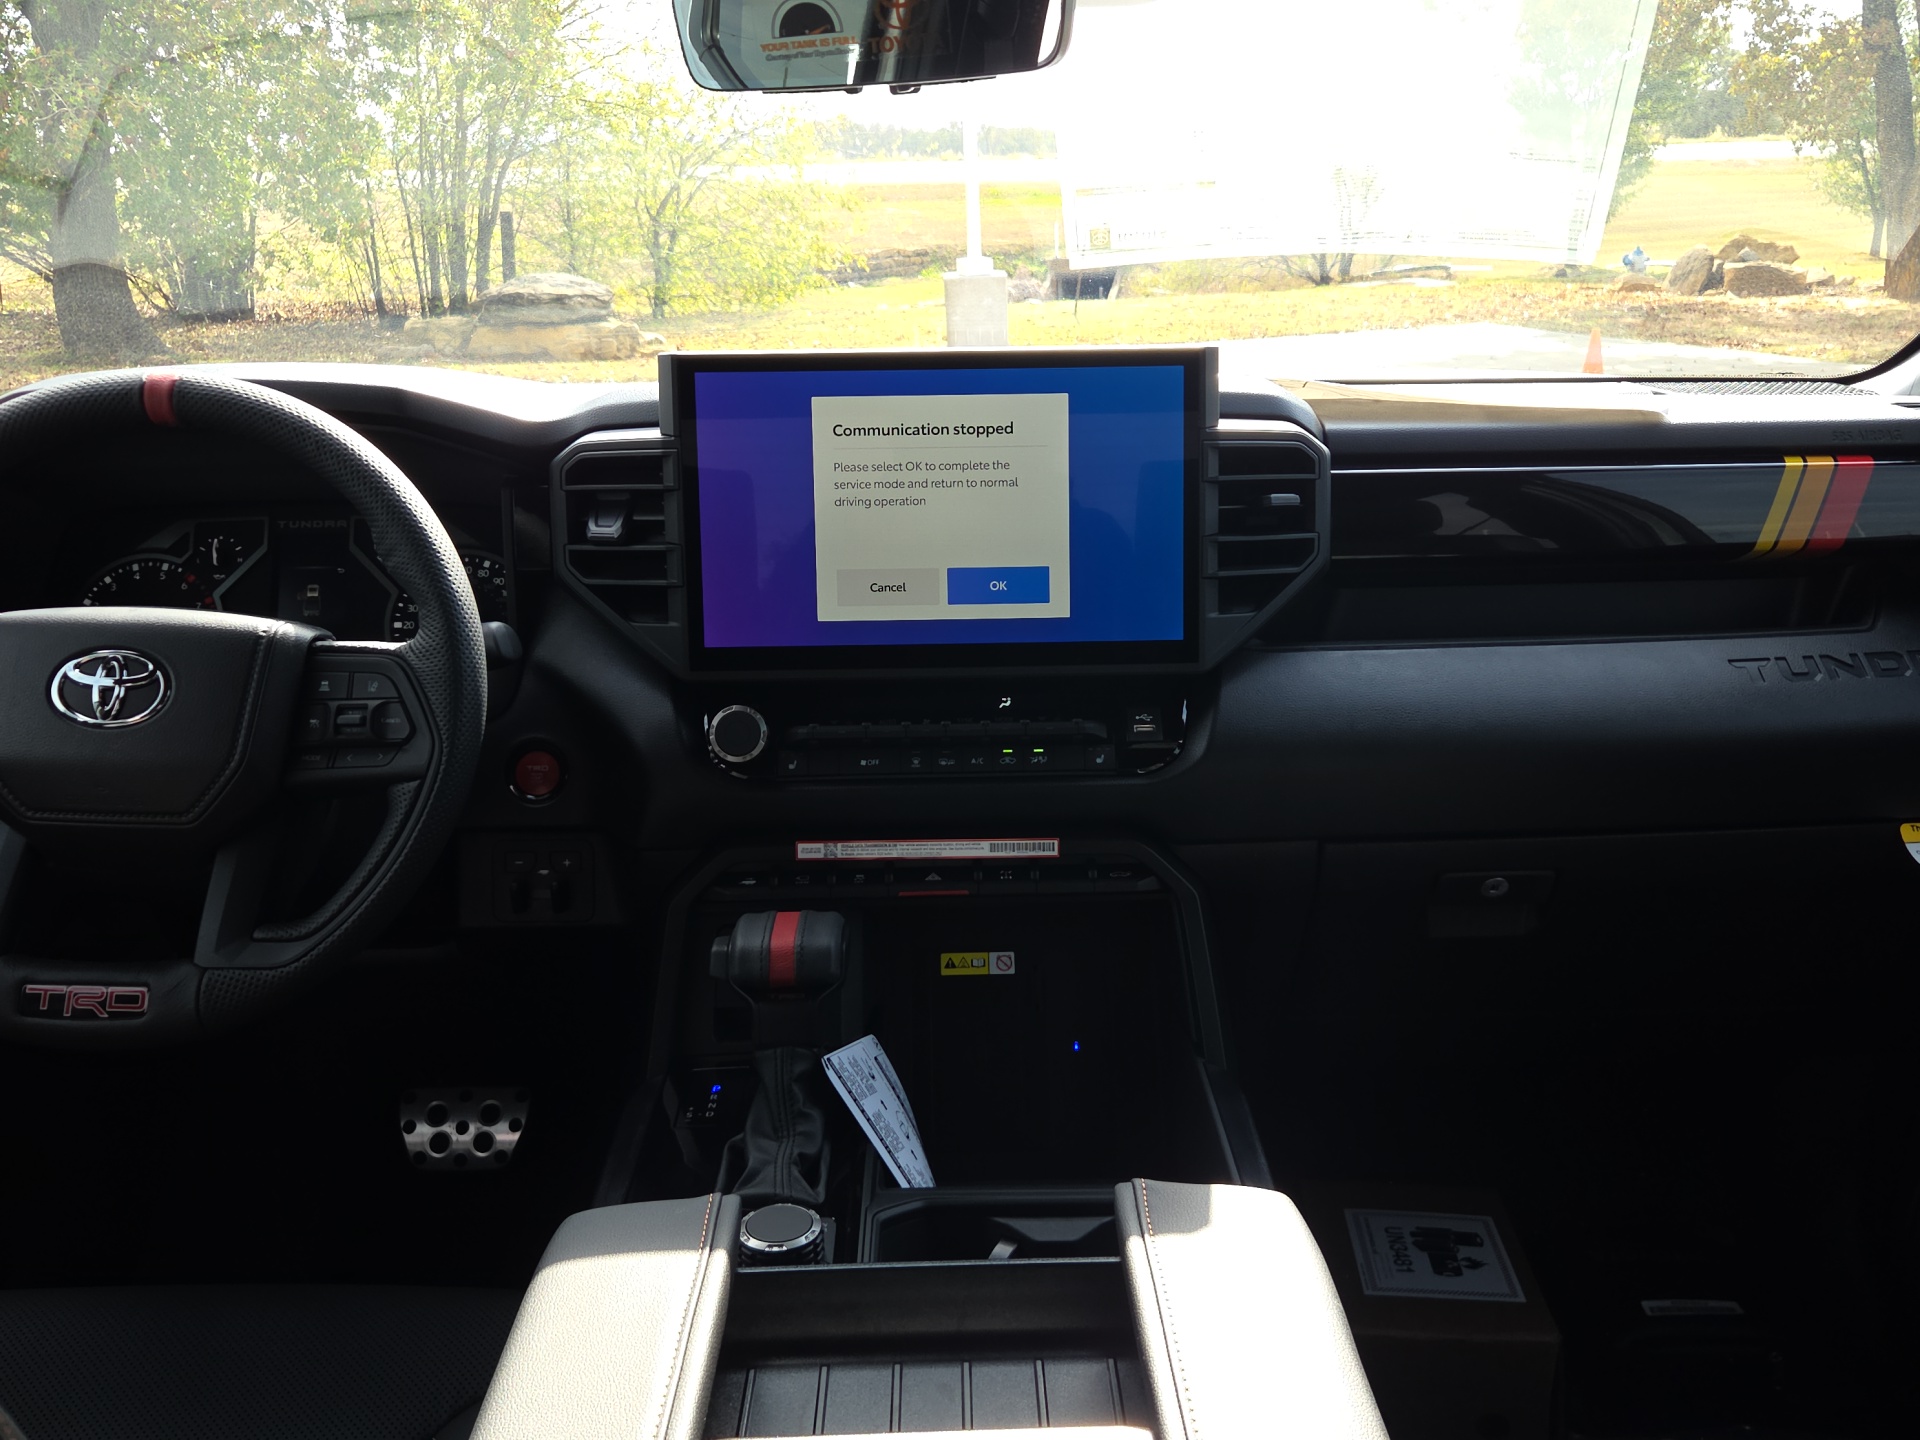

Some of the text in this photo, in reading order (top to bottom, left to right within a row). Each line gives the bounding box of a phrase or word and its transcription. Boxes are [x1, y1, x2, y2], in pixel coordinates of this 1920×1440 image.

[832, 420, 1014, 439] Communication stopped
[833, 460, 1011, 474] Please select OK to complete the
[833, 476, 1019, 490] service mode and return to normal
[834, 495, 927, 510] driving operation
[277, 519, 348, 528] TUNDRA
[134, 572, 141, 581] 4
[160, 571, 166, 580] 5
[477, 569, 489, 577] 80
[110, 581, 117, 591] 3
[180, 581, 188, 591] 6
[493, 577, 505, 586] 90
[989, 580, 1008, 592] OK
[869, 581, 907, 593] Cancel
[407, 604, 419, 613] 30
[403, 621, 415, 629] 20
[866, 758, 880, 767] OFF
[970, 757, 984, 765] A/C
[25, 984, 149, 1018] TRD
[1384, 1226, 1416, 1272] UN3481
